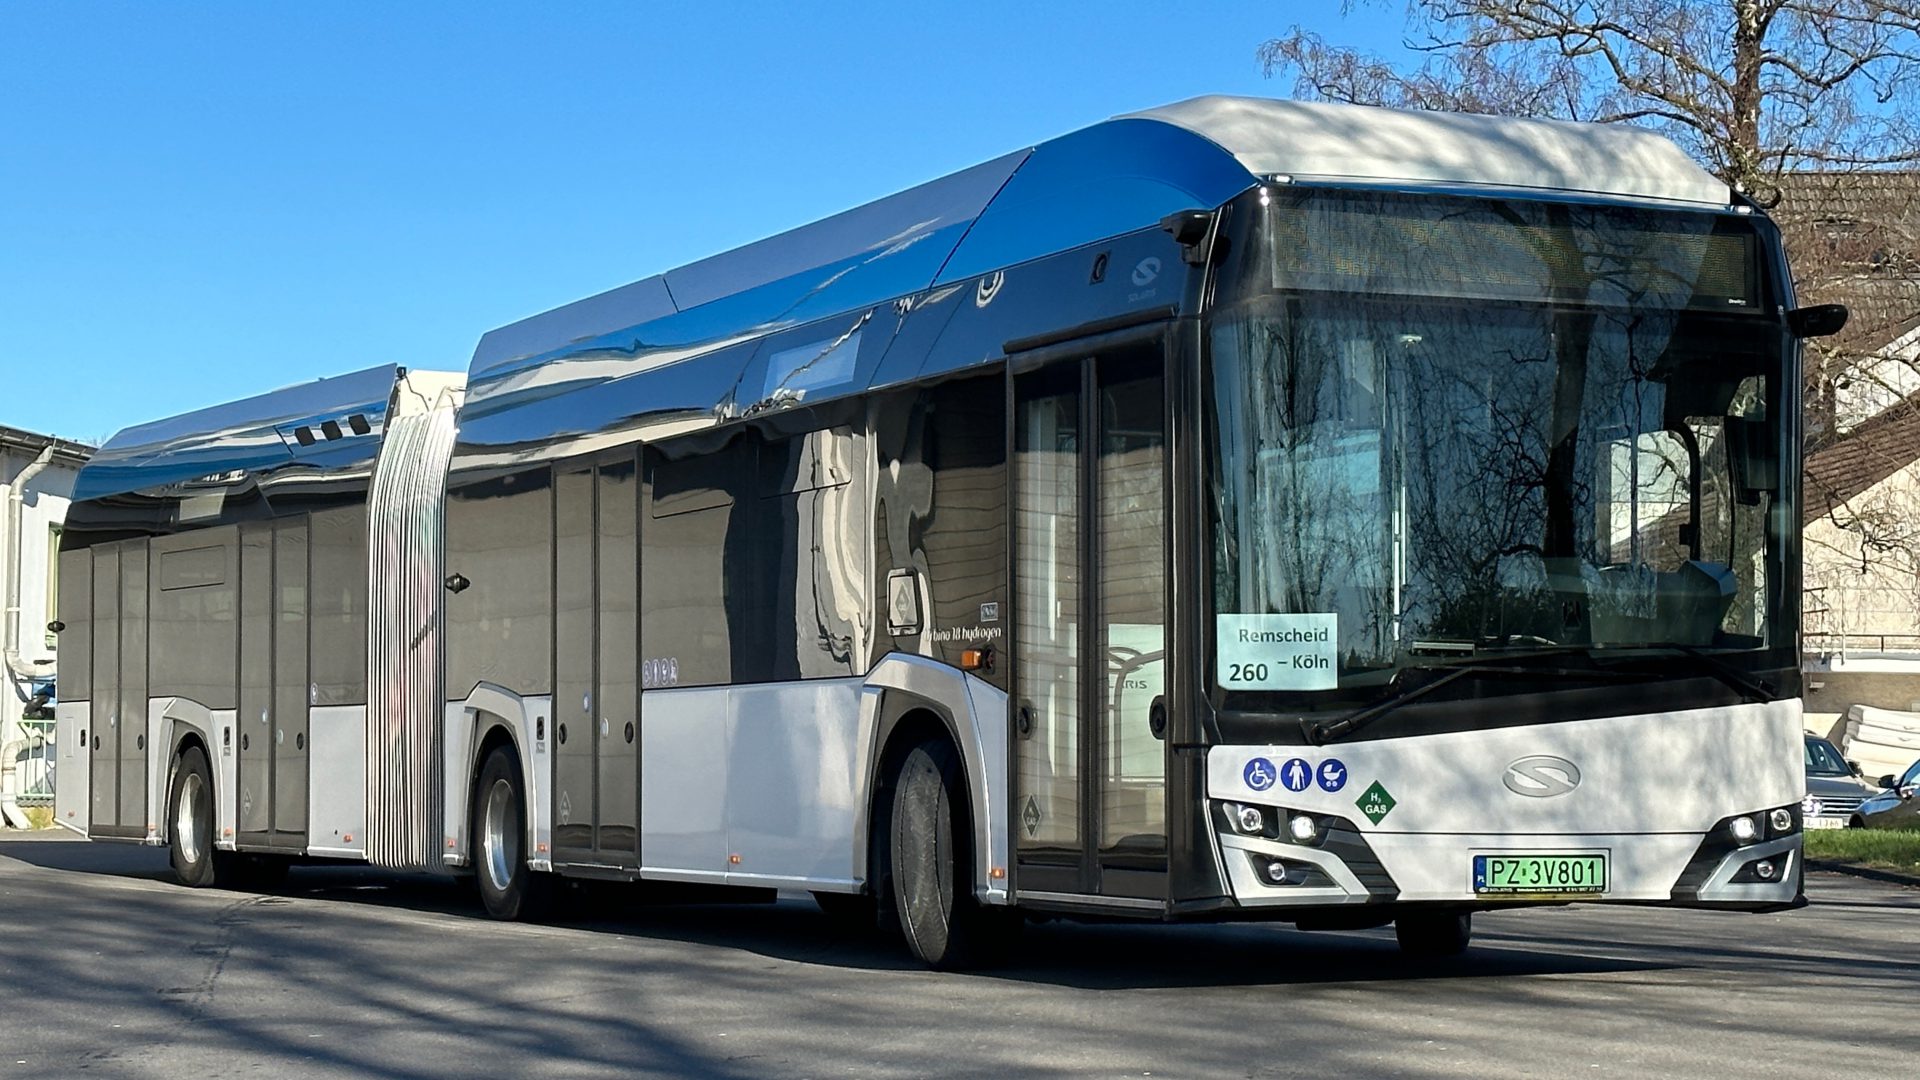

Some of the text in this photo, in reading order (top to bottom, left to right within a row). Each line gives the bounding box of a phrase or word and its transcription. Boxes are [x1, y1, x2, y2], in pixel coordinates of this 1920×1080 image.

[952, 626, 961, 640] 18
[962, 625, 1002, 642] hydrogen
[1239, 627, 1329, 643] Remscheid
[1292, 654, 1329, 669] Köln
[1229, 663, 1268, 682] 260
[1365, 804, 1387, 814] GAS
[1491, 860, 1595, 885] PZ 3V801
